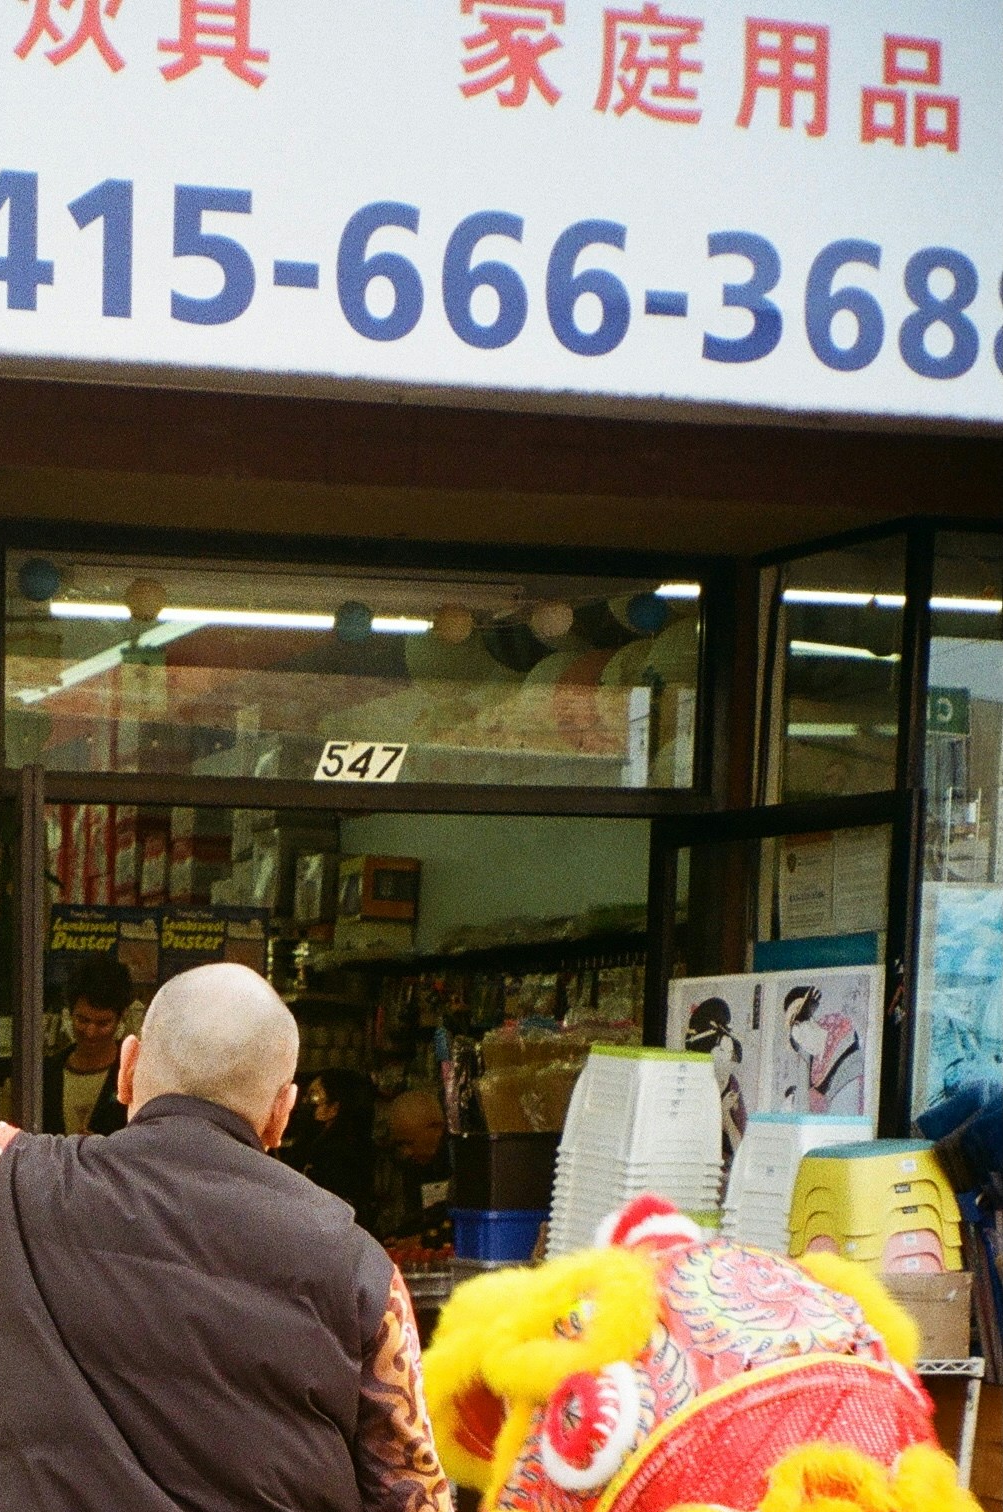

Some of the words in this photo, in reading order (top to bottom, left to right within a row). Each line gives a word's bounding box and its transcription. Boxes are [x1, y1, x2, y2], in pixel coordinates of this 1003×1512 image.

[458, 0, 961, 153] 家庭用品
[322, 744, 403, 778] 547
[51, 931, 117, 950] Duster
[162, 931, 224, 950] Duster
